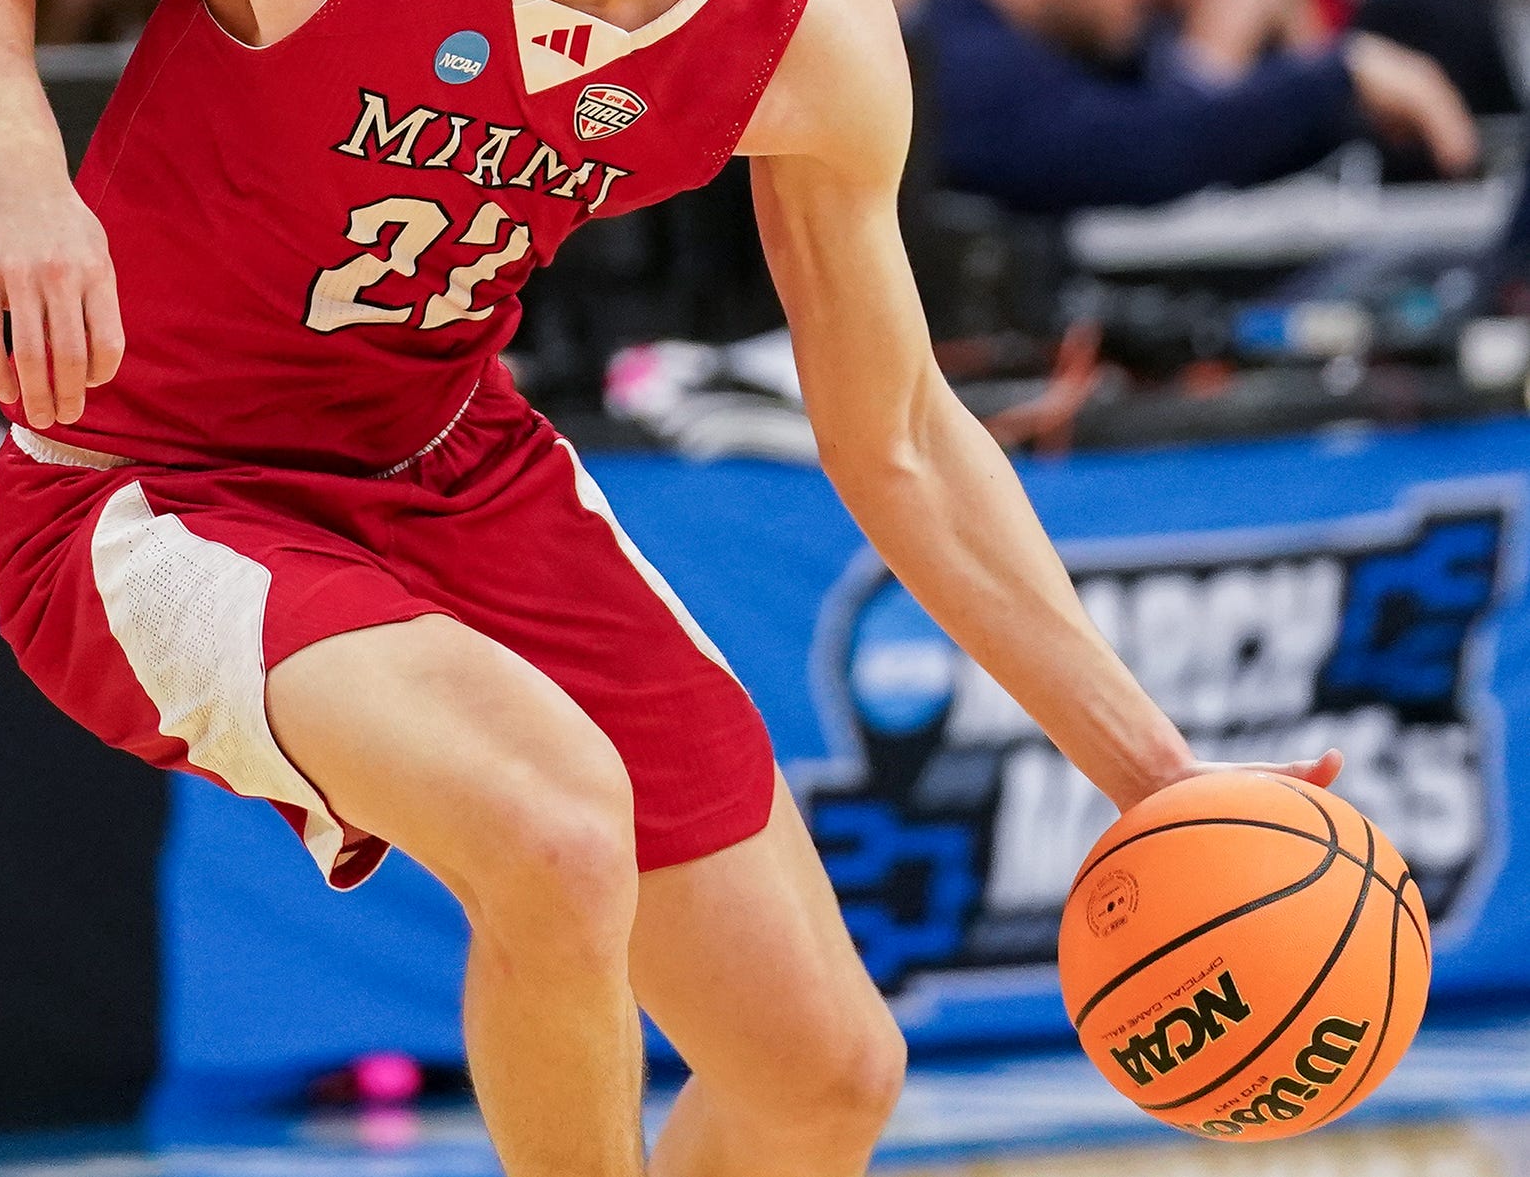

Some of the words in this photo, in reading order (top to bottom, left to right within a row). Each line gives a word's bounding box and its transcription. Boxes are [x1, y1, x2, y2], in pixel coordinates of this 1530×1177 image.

[438, 52, 482, 76] NCAA
[329, 86, 635, 214] MIAMI
[576, 98, 635, 128] MAC
[304, 194, 532, 333] 22
[1127, 1002, 1163, 1029] GAME
[1163, 956, 1224, 1001] OFFICIAL
[1109, 968, 1254, 1088] NCAA
[1180, 1015, 1371, 1137] Wilso
